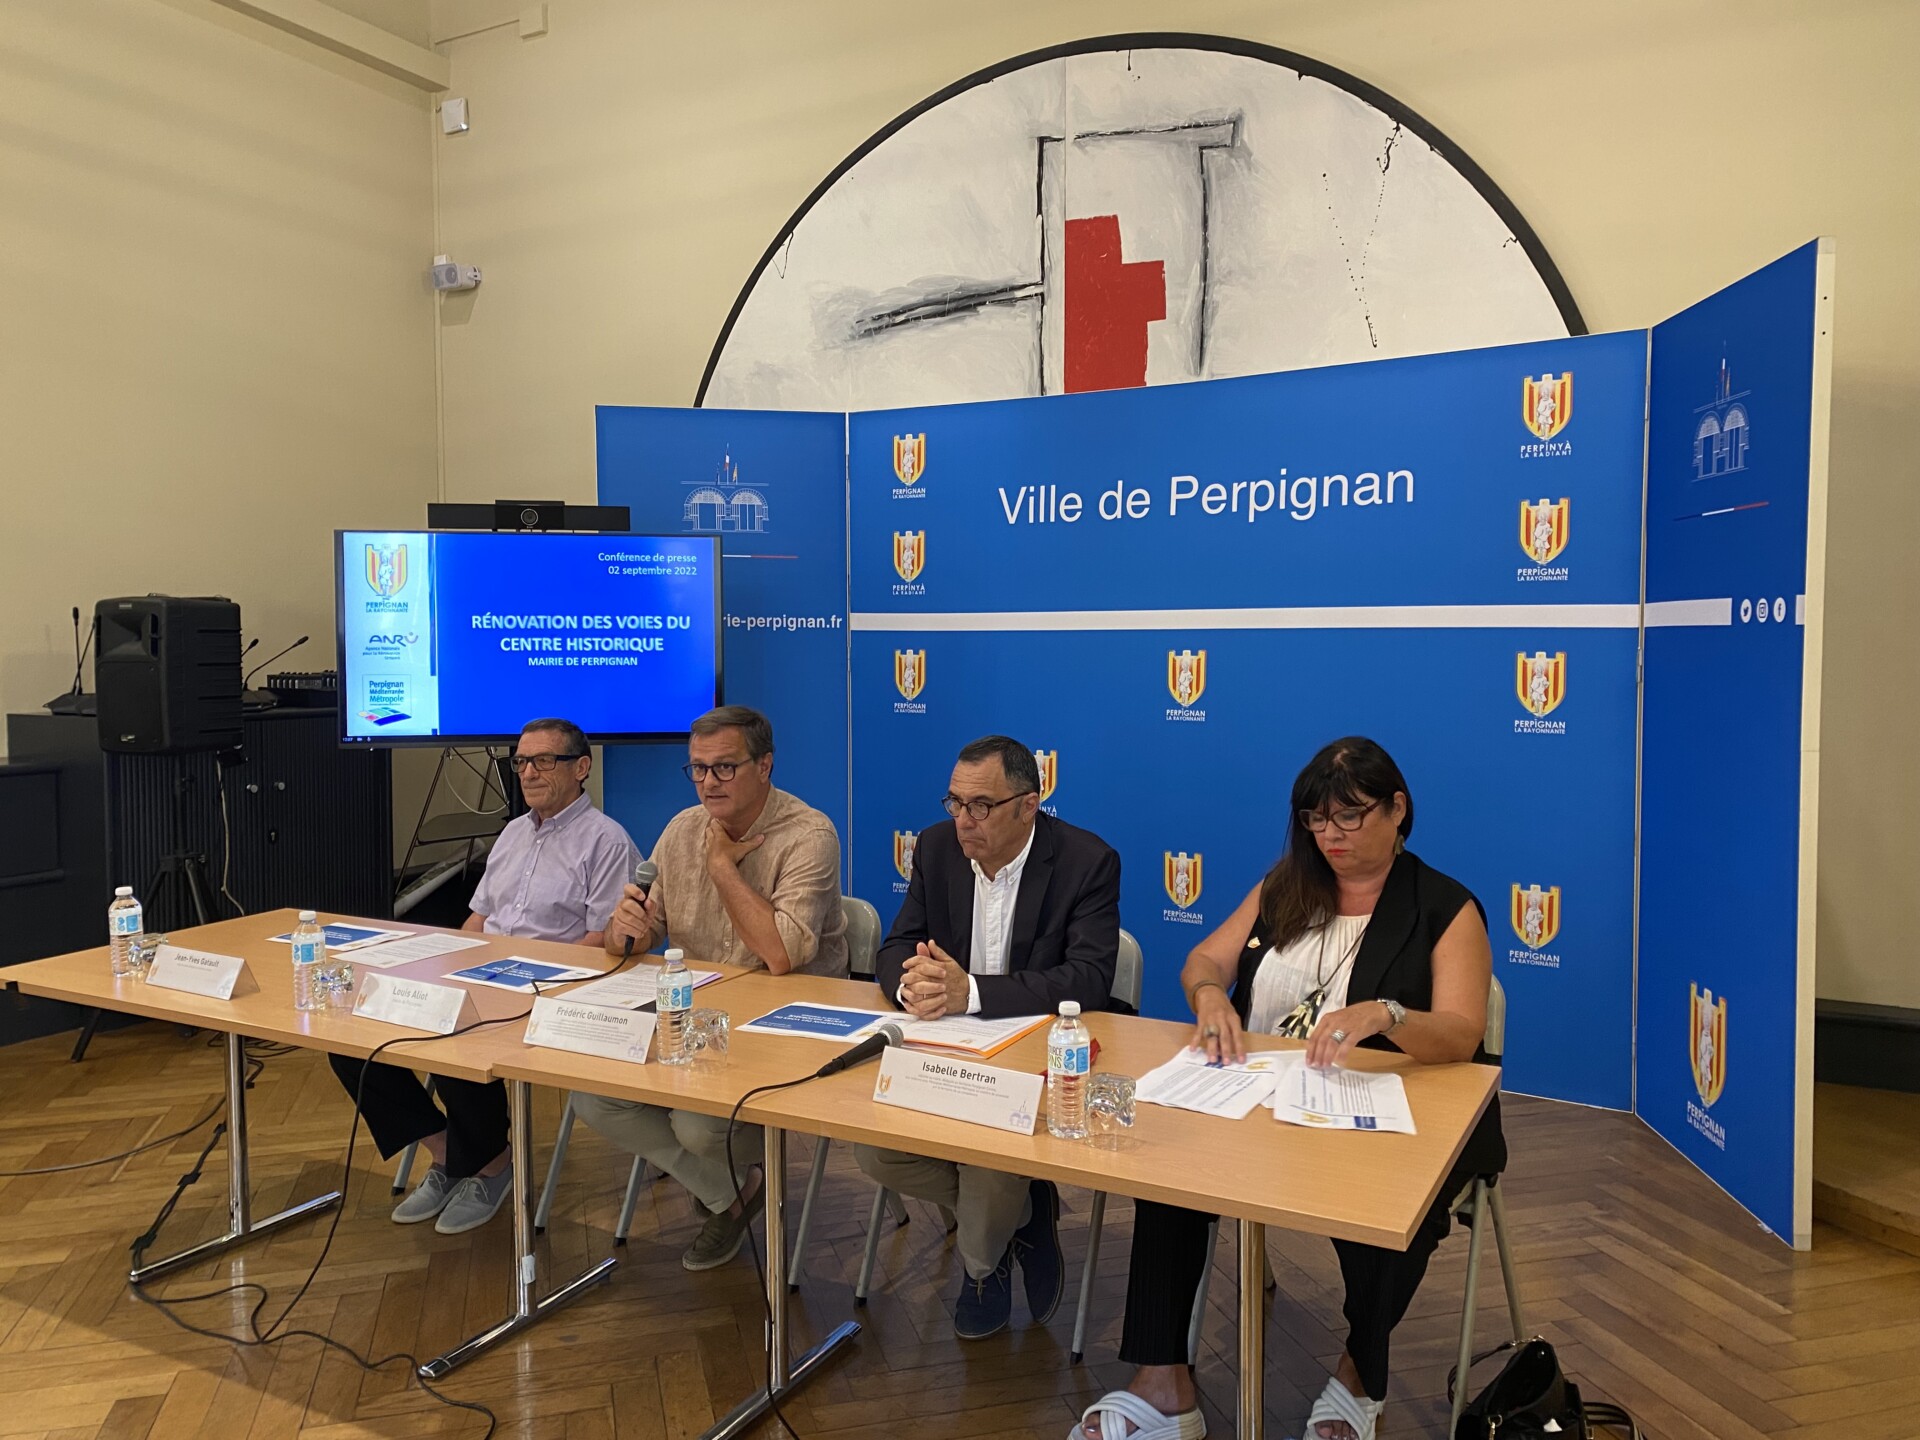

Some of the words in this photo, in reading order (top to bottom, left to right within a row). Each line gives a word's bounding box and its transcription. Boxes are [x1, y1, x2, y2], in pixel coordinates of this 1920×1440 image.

[1520, 440, 1571, 453] PERPINYÀ
[892, 487, 926, 495] PERPIGNAN
[999, 484, 1083, 524] Ville
[1098, 480, 1151, 521] de
[1169, 468, 1415, 523] Perpignan
[598, 552, 651, 562] Conférence
[653, 552, 665, 562] de
[667, 554, 697, 564] presse
[608, 565, 620, 575] 02
[622, 565, 672, 576] septembre
[674, 566, 697, 575] 2022
[1517, 566, 1568, 576] PERPIGNAN
[366, 601, 408, 609] PERPIGNAN
[471, 612, 578, 629] RÉNOVATION
[582, 615, 612, 629] DES
[616, 615, 663, 629] VOIES
[667, 615, 690, 630] DU
[500, 637, 562, 651] CENTRE
[567, 637, 664, 653] HISTORIQUE
[528, 657, 564, 666] MAIRIE
[566, 657, 579, 666] DE
[581, 657, 638, 666] PERPIGNAN
[369, 680, 404, 690] Perpignan
[369, 694, 404, 705] Métropole
[1166, 708, 1205, 717] PERPIGNAN
[1514, 719, 1566, 729] PERPIGNAN
[1163, 909, 1203, 920] PERPIGNAN
[1509, 950, 1560, 963] PERPIGNAN
[392, 986, 411, 998] Louis
[556, 1007, 586, 1019] Frédéric
[587, 1011, 629, 1025] Guillaumon
[922, 1061, 958, 1077] Isabelle
[960, 1068, 996, 1085] Bertran
[1687, 1101, 1725, 1141] PERPIGNAN
